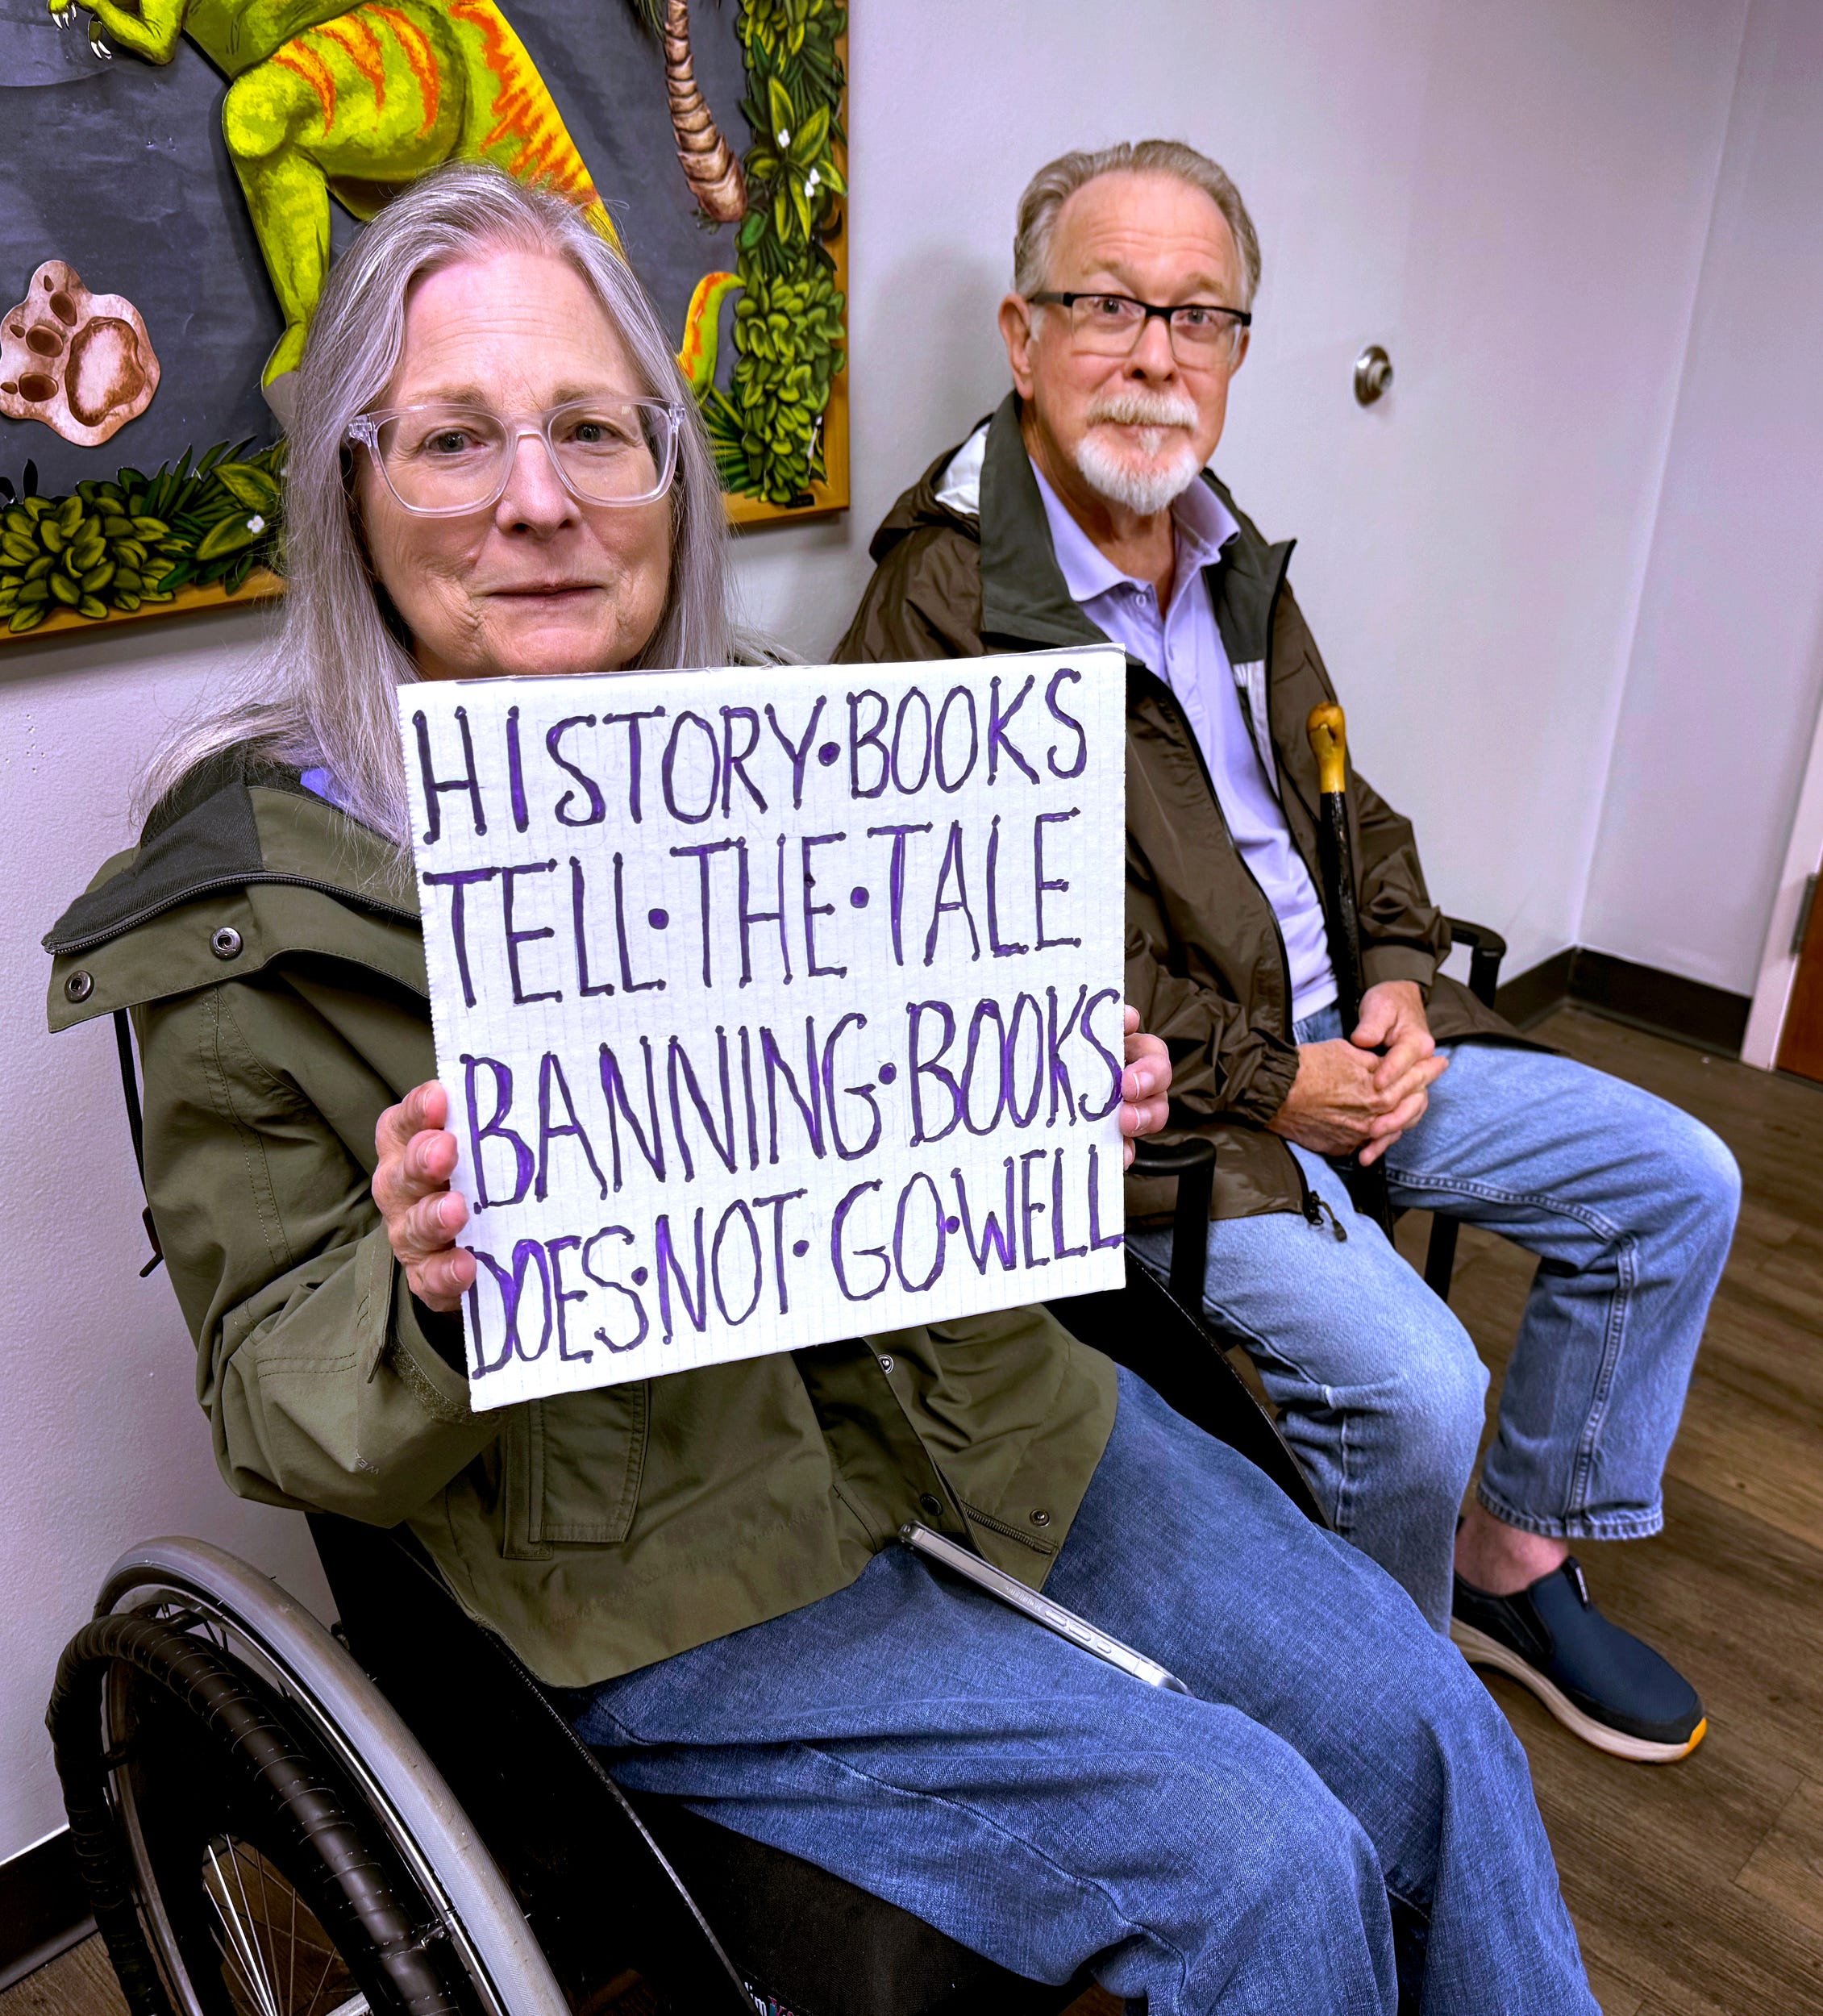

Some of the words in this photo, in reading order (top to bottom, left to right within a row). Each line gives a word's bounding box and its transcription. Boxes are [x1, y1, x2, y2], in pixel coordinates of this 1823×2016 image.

[414, 696, 826, 843] HISTORY
[847, 669, 1087, 799] BOOKS
[423, 853, 666, 1007] TELL
[670, 832, 847, 989] THE
[867, 808, 1081, 966] TALE
[460, 1013, 880, 1213] BANNING
[906, 985, 1123, 1147] BOOKS
[464, 1225, 648, 1379] DOES
[656, 1189, 807, 1344] NOT
[831, 1172, 945, 1301] GO
[951, 1144, 1125, 1275] WELL
